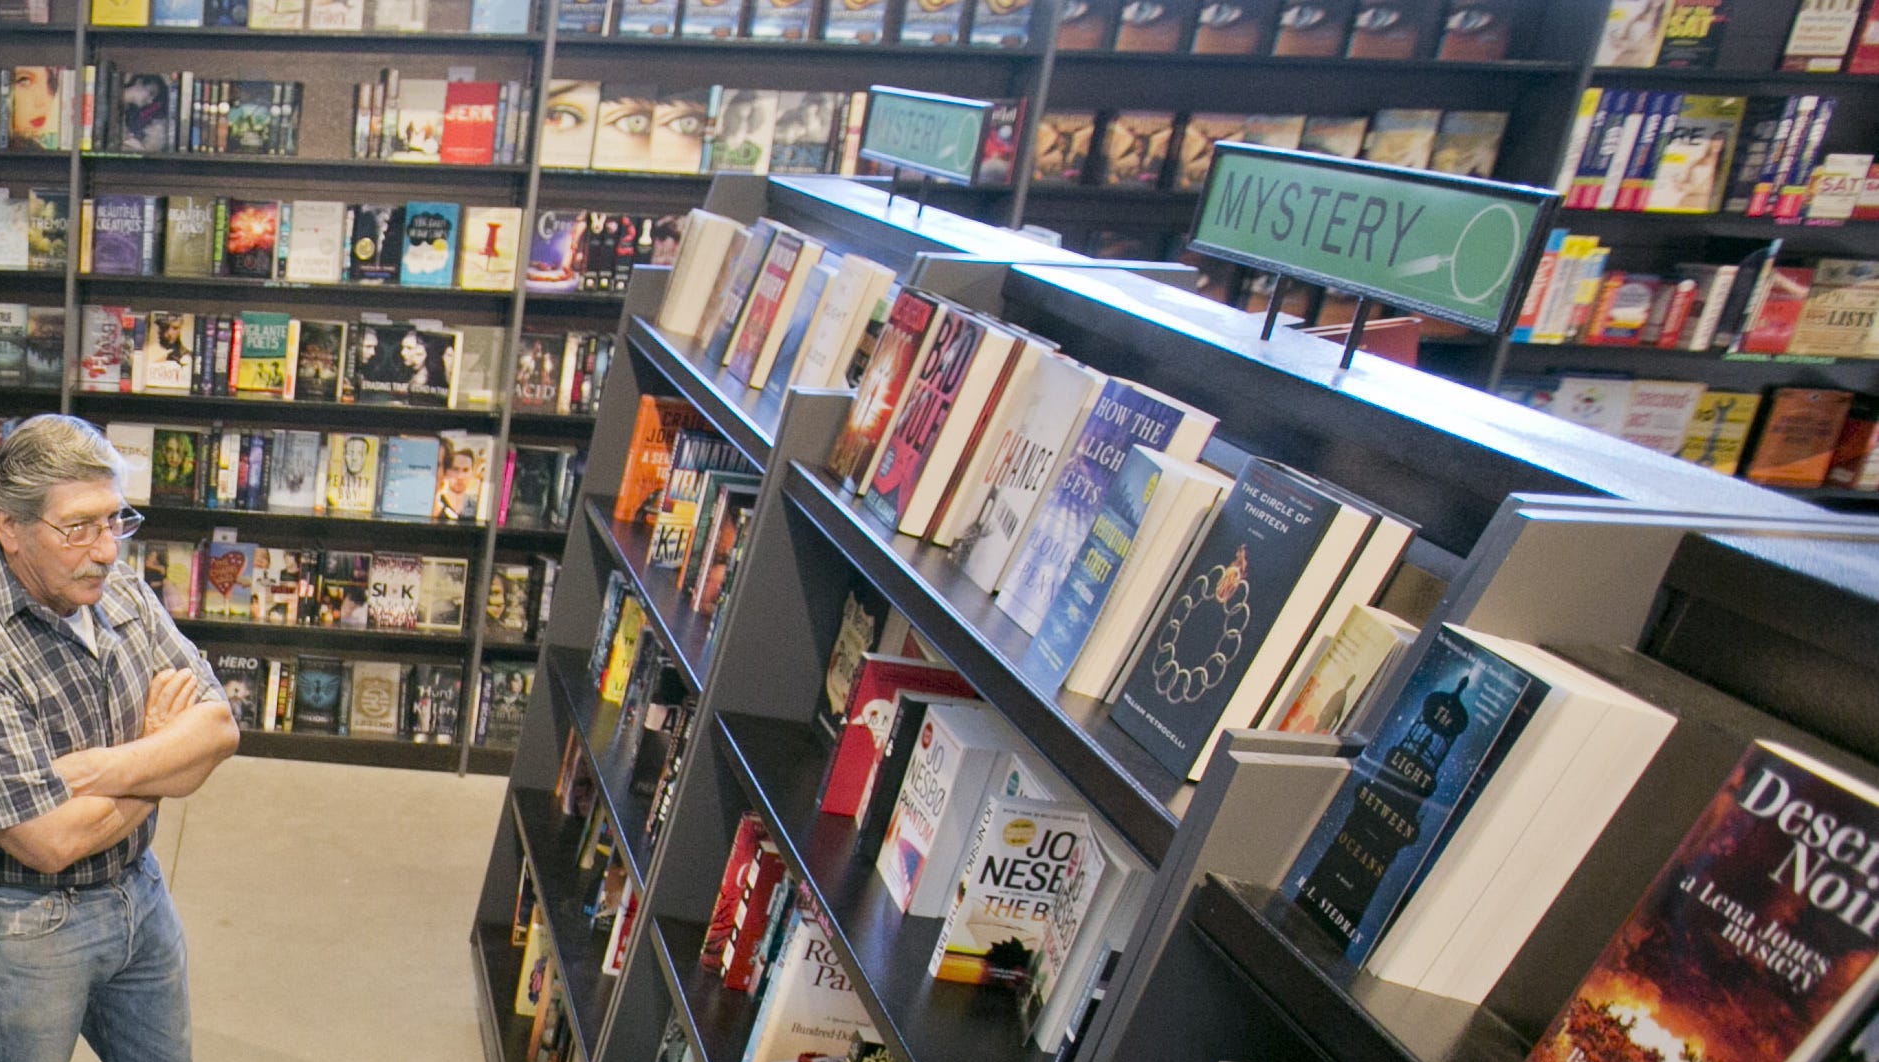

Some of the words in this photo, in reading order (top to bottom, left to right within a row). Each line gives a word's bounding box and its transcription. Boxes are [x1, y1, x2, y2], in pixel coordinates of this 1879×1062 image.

[1663, 12, 1710, 38] SAT
[447, 104, 495, 123] JERK
[871, 105, 951, 151] MYSTERY
[1820, 176, 1860, 195] SAT
[95, 202, 143, 219] BEAUTIFUL
[1215, 170, 1431, 268] MYSTERY
[1828, 310, 1876, 329] LISTS
[244, 335, 280, 351] POETS
[1093, 400, 1131, 426] HOW
[1131, 416, 1166, 445] THE
[984, 429, 1053, 493] CHANCE
[1062, 468, 1101, 505] GETS
[1241, 480, 1264, 500] THE
[1260, 490, 1297, 516] CIRCLE
[1294, 508, 1312, 527] OF
[1241, 501, 1291, 535] THIRTEEN
[218, 655, 259, 670] HERO
[1121, 691, 1152, 722] WILLIAM
[1148, 711, 1187, 750] PETROCELLI
[1433, 704, 1456, 729] The
[1390, 749, 1434, 790] LIGHT
[1357, 783, 1417, 840] BETWEEN
[1026, 831, 1078, 862] JO
[1336, 831, 1387, 879] OCEANS
[982, 894, 1028, 920] THE
[1320, 898, 1366, 943] STEDMAN
[1697, 878, 1758, 929] Lena
[1761, 921, 1833, 979] Jones
[1720, 903, 1820, 994] mystery
